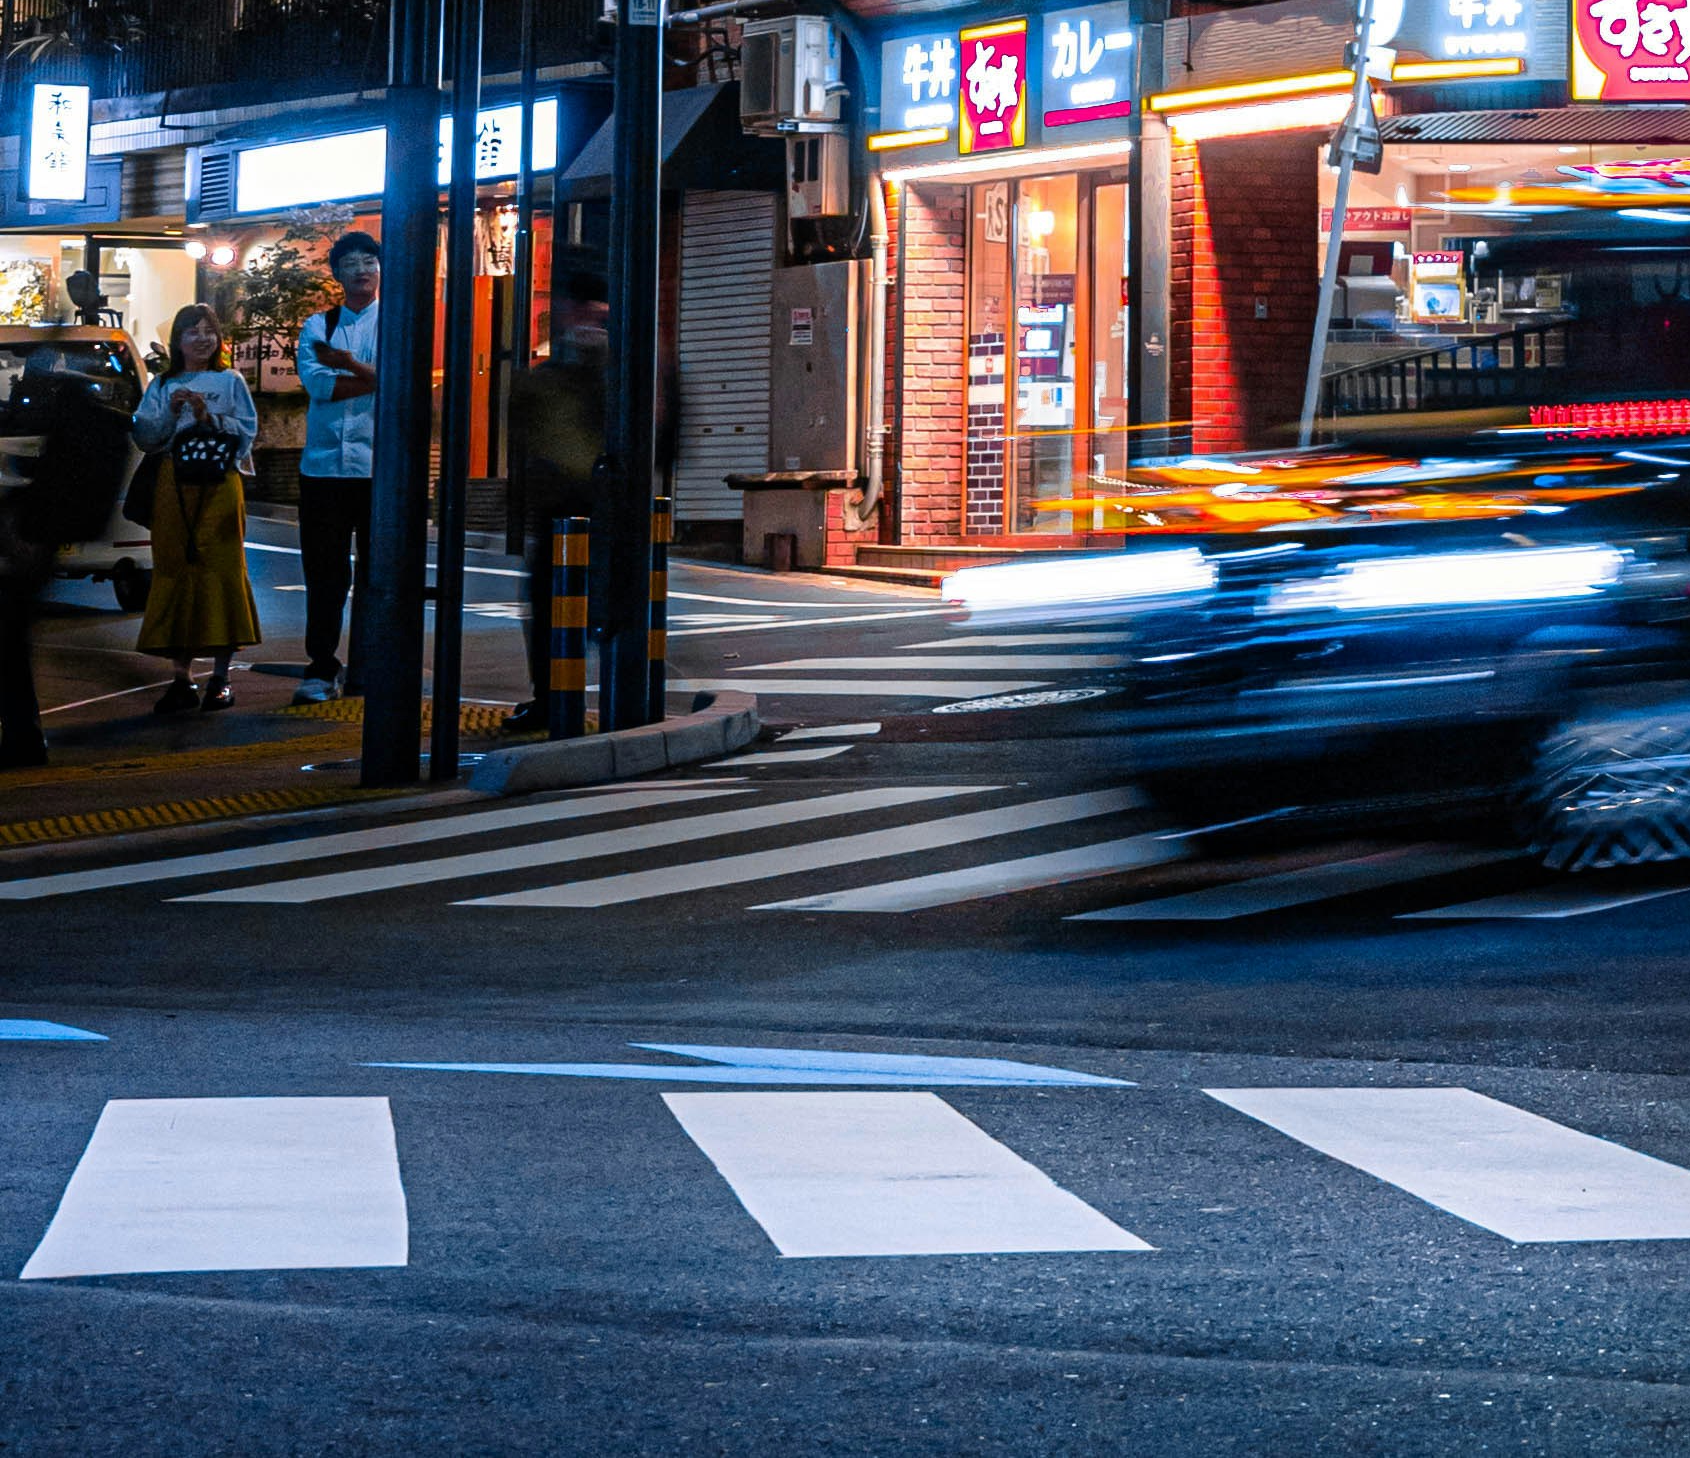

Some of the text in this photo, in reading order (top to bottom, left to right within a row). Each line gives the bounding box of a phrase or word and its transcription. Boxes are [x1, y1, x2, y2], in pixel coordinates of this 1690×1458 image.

[902, 38, 956, 102] 牛丼
[1051, 20, 1133, 79] カレー
